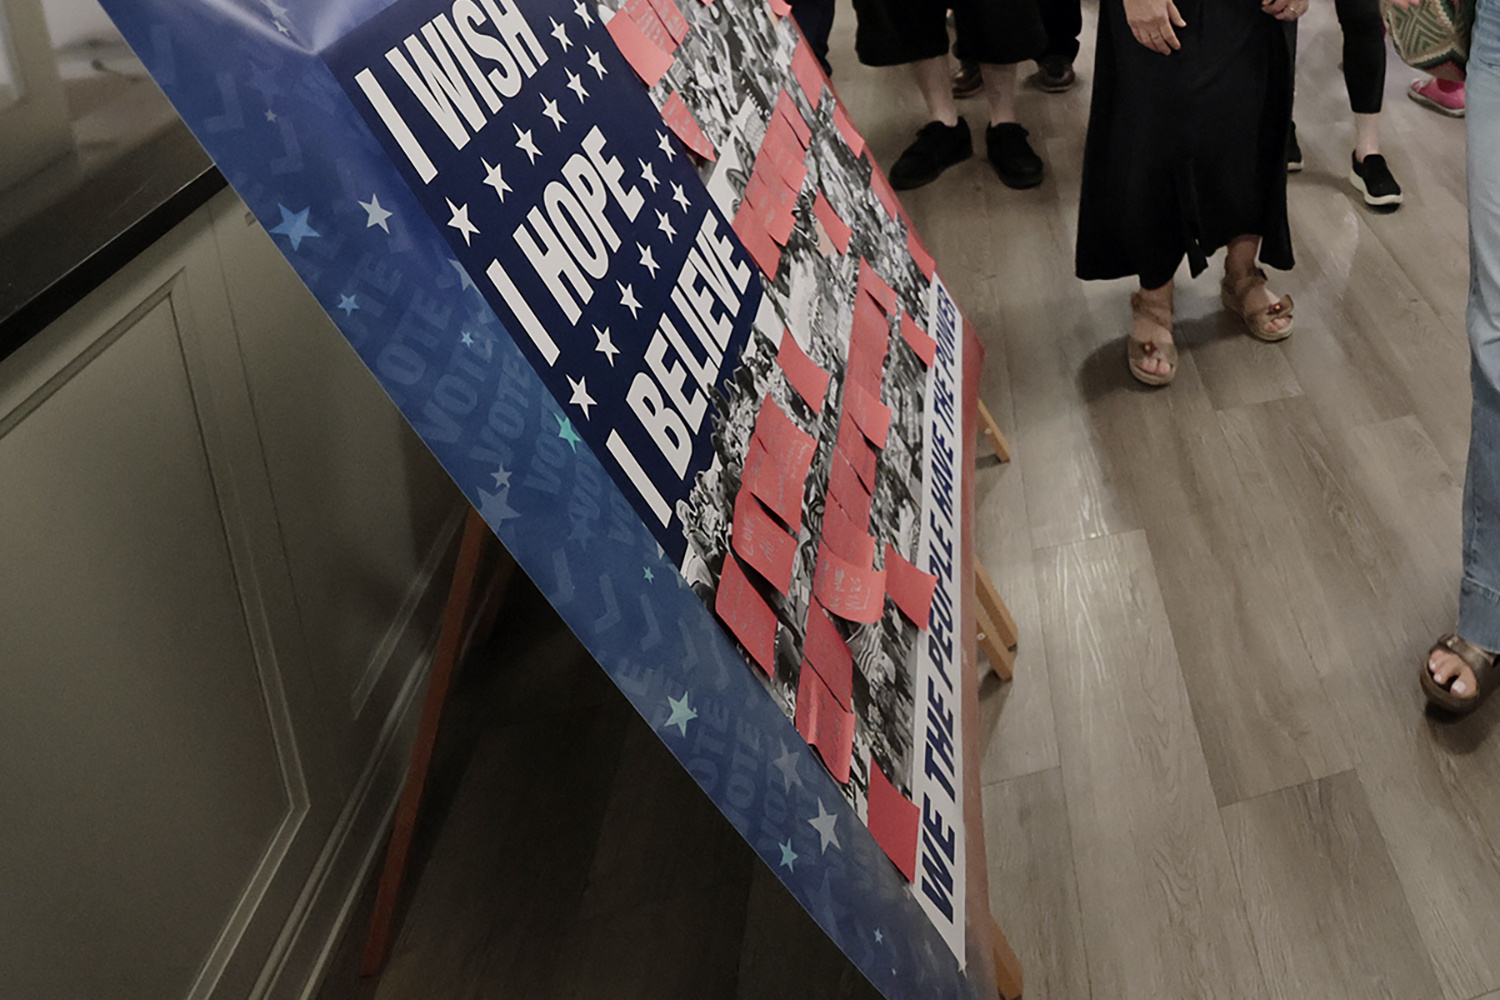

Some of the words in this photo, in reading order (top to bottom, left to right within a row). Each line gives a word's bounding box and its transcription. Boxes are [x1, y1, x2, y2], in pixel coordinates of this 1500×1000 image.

[354, 67, 439, 185] I
[512, 125, 646, 327] HOPE
[376, 286, 454, 387] OTE
[485, 258, 561, 367] I
[626, 209, 752, 481] BELIEVE
[935, 283, 956, 384] POWER
[468, 352, 531, 466] VOTE
[933, 365, 955, 437] THE
[605, 428, 673, 529] I
[930, 420, 954, 529] HAVE
[928, 509, 954, 694] PEOPLE
[924, 675, 956, 804] THE
[921, 791, 955, 925] WE
